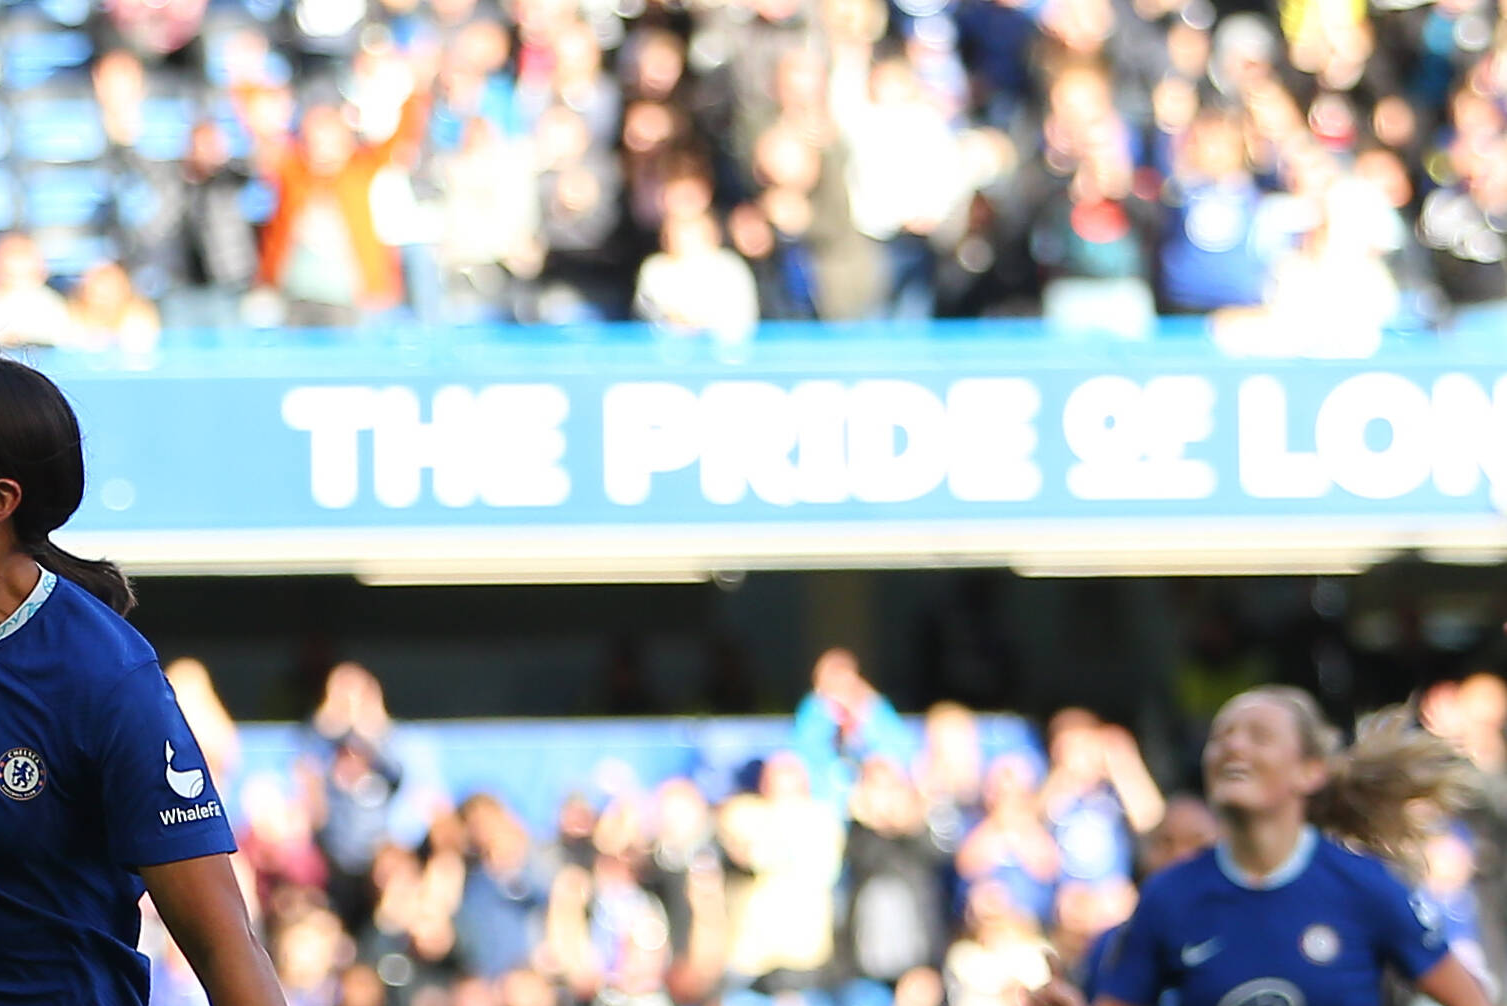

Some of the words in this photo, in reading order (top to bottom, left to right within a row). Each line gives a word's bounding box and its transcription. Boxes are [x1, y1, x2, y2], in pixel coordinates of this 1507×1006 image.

[281, 383, 570, 508] THE
[603, 378, 1042, 506] PRIDE
[1063, 374, 1218, 500] OF
[159, 800, 222, 826] WhaleFi
